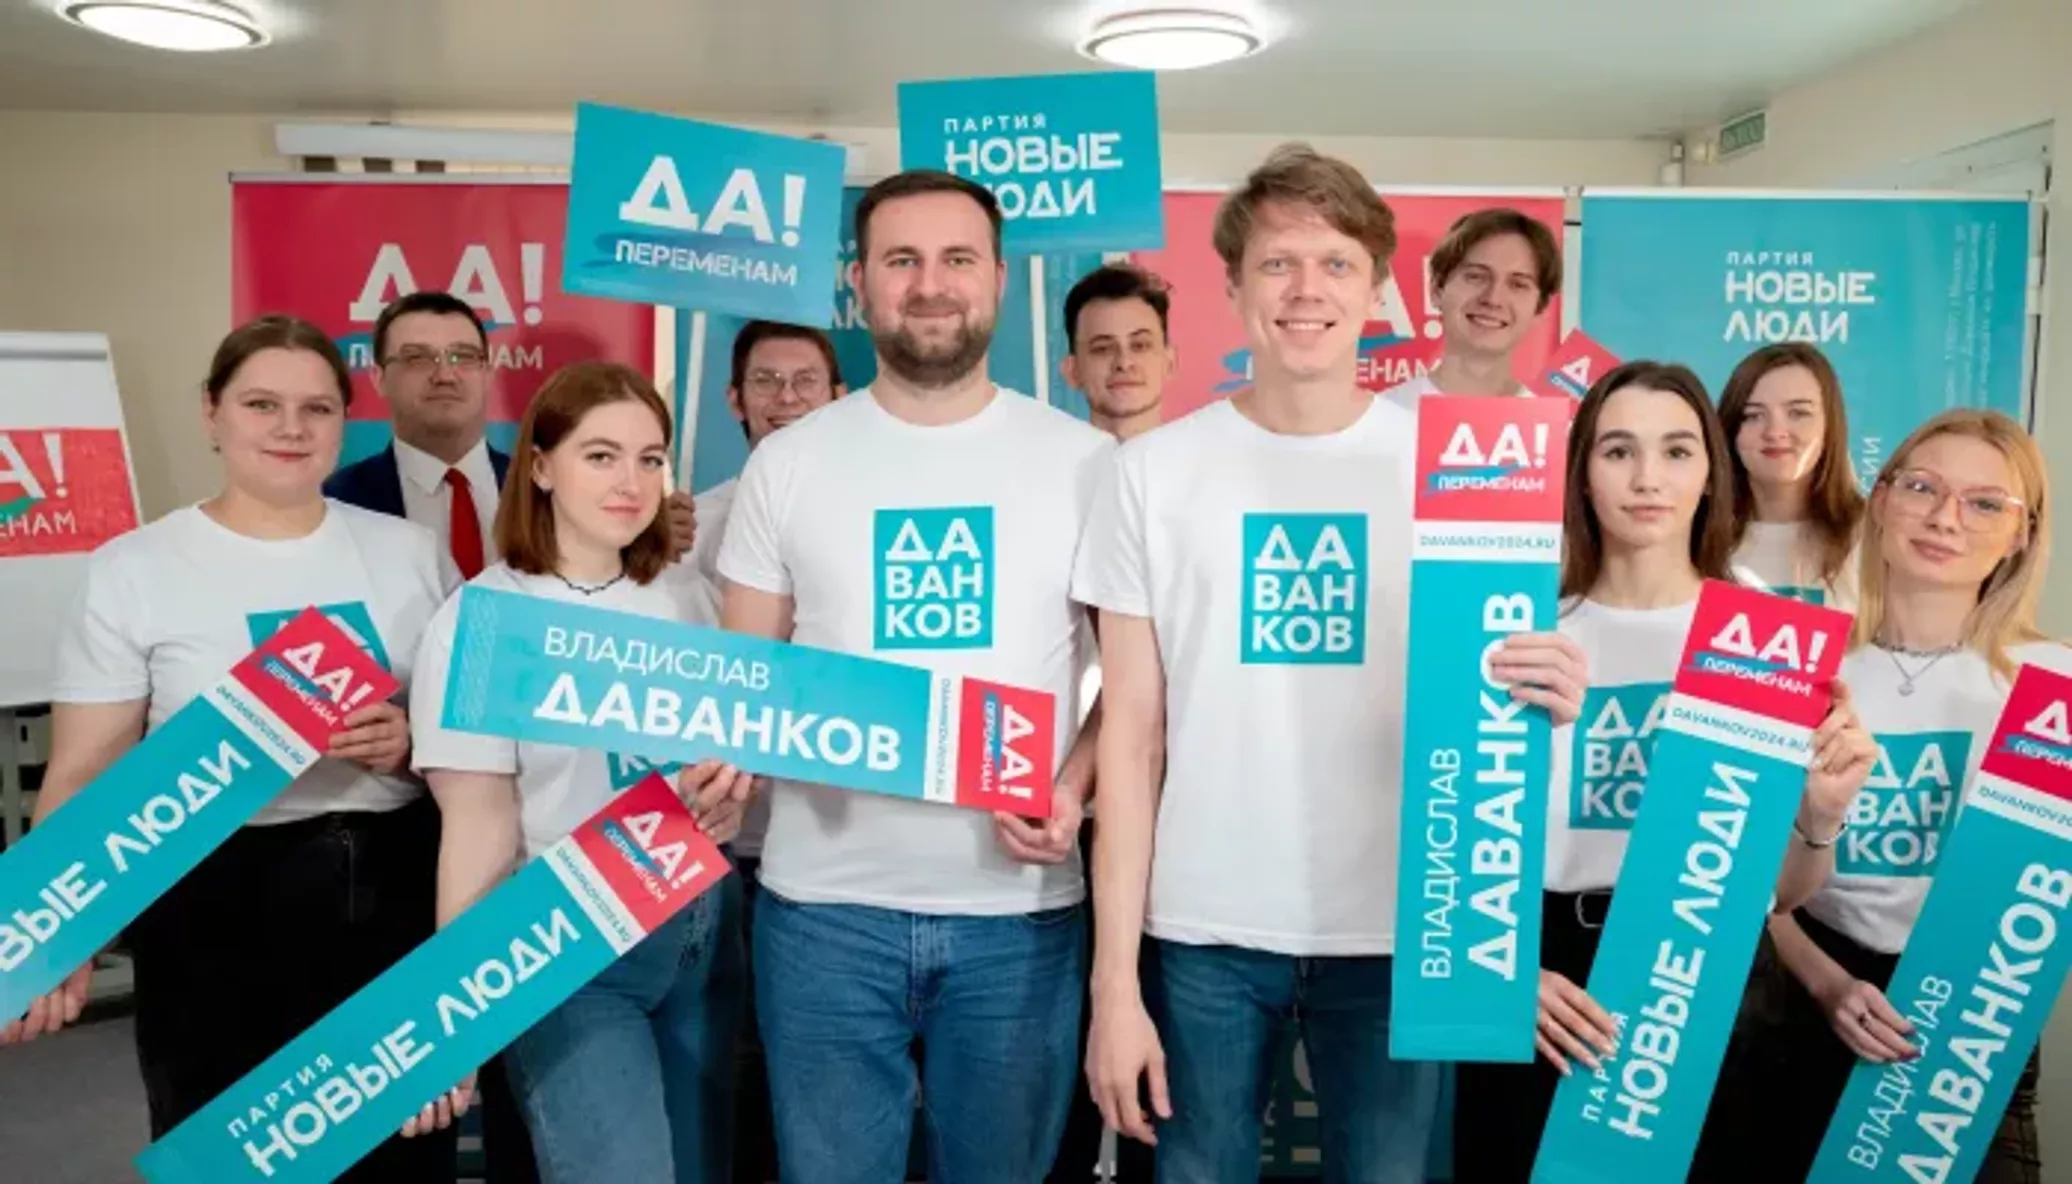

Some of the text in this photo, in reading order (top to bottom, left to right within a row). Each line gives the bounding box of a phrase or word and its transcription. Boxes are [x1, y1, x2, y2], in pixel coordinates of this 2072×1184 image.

[944, 112, 1047, 134] ПАРТИЯ
[945, 132, 1124, 176] НОВЫЕ
[618, 154, 806, 247] ДА!
[983, 178, 1096, 220] ЮДИ
[614, 239, 798, 287] ПЕРЕМЕНАМ
[1726, 251, 1814, 267] ПАРТИЯ
[349, 242, 544, 326] ДА!
[1725, 269, 1876, 304] НОВЫЕ
[1723, 309, 1849, 344] ЛЮДИ
[1439, 422, 1549, 469] ДА!
[1437, 475, 1546, 492] ПЕРЕМЕНАМ
[885, 517, 982, 561] ДА
[1253, 523, 1355, 571] ДА
[1420, 534, 1556, 549] DAVANKOV2024.RU
[885, 562, 983, 600] ВАН
[1253, 573, 1356, 612] ВАН
[885, 603, 982, 638] КОВ
[1252, 615, 1354, 653] КОВ
[1710, 612, 1828, 674] ДА!
[282, 641, 374, 712] ДА!
[544, 626, 771, 691] ВЛАДИСЛАВ
[1704, 656, 1812, 697] ПЕРЕМЕНАМ
[532, 671, 902, 773] ДАВАНКОВ
[998, 704, 1036, 799] ДА!
[1584, 739, 1658, 777] ВА
[104, 739, 251, 873] ЛЮДИ
[1582, 780, 1646, 818] КО
[621, 810, 705, 890] ДА!
[1421, 747, 1461, 979] ВЛАДИСЛАВ
[1608, 760, 1760, 1140] НОВЫЕ ЛЮДИ
[243, 907, 581, 1177] НОВЫЕ ЛЮДИ
[227, 1053, 333, 1139] ПАРТИЯ
